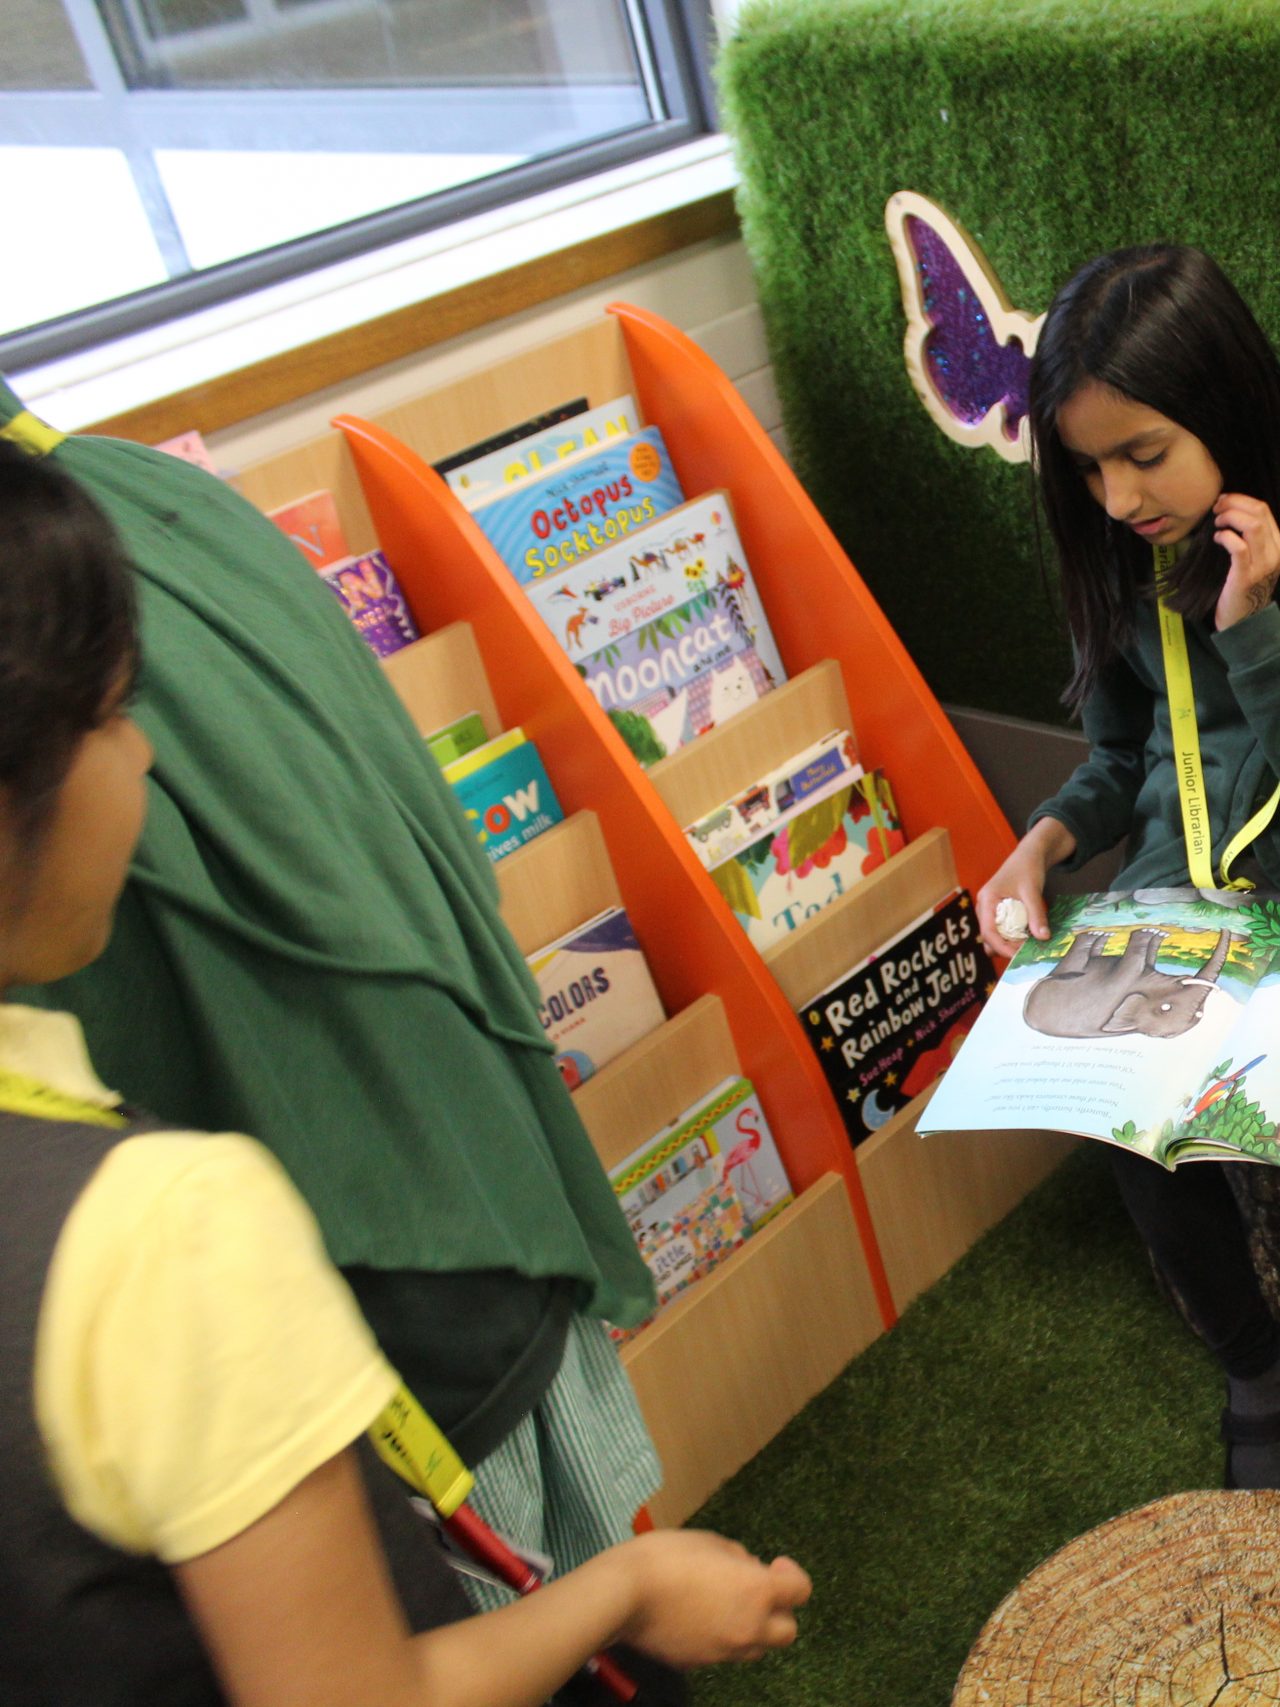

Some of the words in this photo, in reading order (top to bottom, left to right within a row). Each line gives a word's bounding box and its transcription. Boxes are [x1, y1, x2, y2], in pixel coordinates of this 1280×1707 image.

[525, 496, 656, 578] Socktopus
[530, 474, 634, 539] Octopus
[583, 613, 732, 705] mooncat
[1182, 751, 1197, 793] Junior
[487, 836, 520, 863] ives
[521, 814, 553, 841] milk
[1188, 797, 1205, 855] Librarian
[536, 966, 609, 1029] COLORS
[825, 978, 879, 1036] Red
[880, 915, 971, 995] Rockets
[895, 977, 919, 1005] and
[841, 997, 925, 1069] Rainbow
[926, 952, 977, 1008] Jelly
